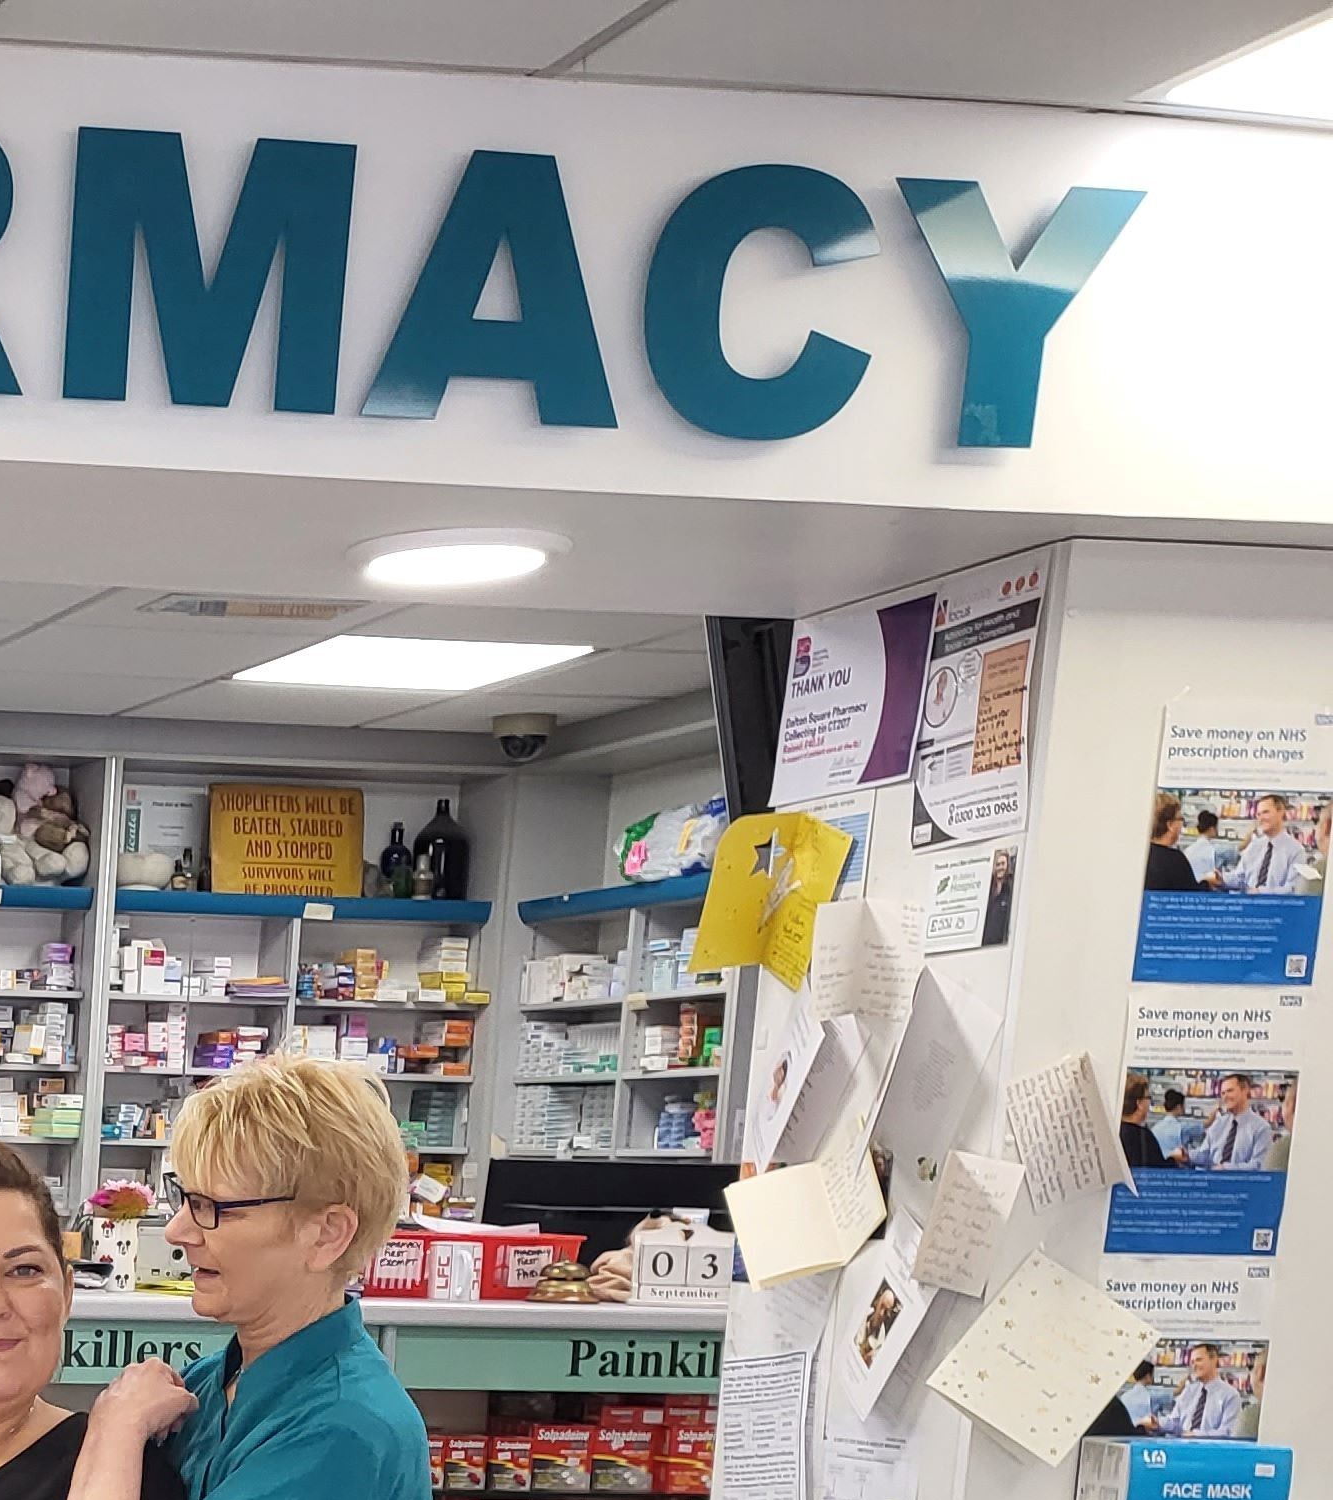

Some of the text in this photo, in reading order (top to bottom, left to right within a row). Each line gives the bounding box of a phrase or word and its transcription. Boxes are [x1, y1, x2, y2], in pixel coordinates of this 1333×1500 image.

[791, 667, 851, 698] THANK YOU
[833, 703, 868, 720] Pharmacy
[1171, 725, 1307, 743] Save money on NHS
[1168, 744, 1304, 762] prescription charges
[219, 793, 356, 815] SHOPLIFTERS WILL BE
[994, 800, 1019, 816] 0965
[234, 817, 343, 837] BEATEN, STABBED
[246, 840, 333, 860] AND STOMPED
[242, 867, 335, 881] SURVIVORS WILL
[263, 884, 333, 897] PROSECUTED
[1138, 1007, 1271, 1024] Save money on NHS
[1136, 1026, 1269, 1043] prescription charges
[437, 1256, 450, 1290] LFC
[651, 1251, 719, 1280] 0 3
[650, 1287, 720, 1299] September
[1106, 1279, 1239, 1296] Save money on NHS
[1187, 1298, 1236, 1313] charges
[538, 1429, 590, 1442] Solpadeine
[599, 1429, 651, 1443] Solpadeine
[1163, 1484, 1252, 1500] FACE MASK
